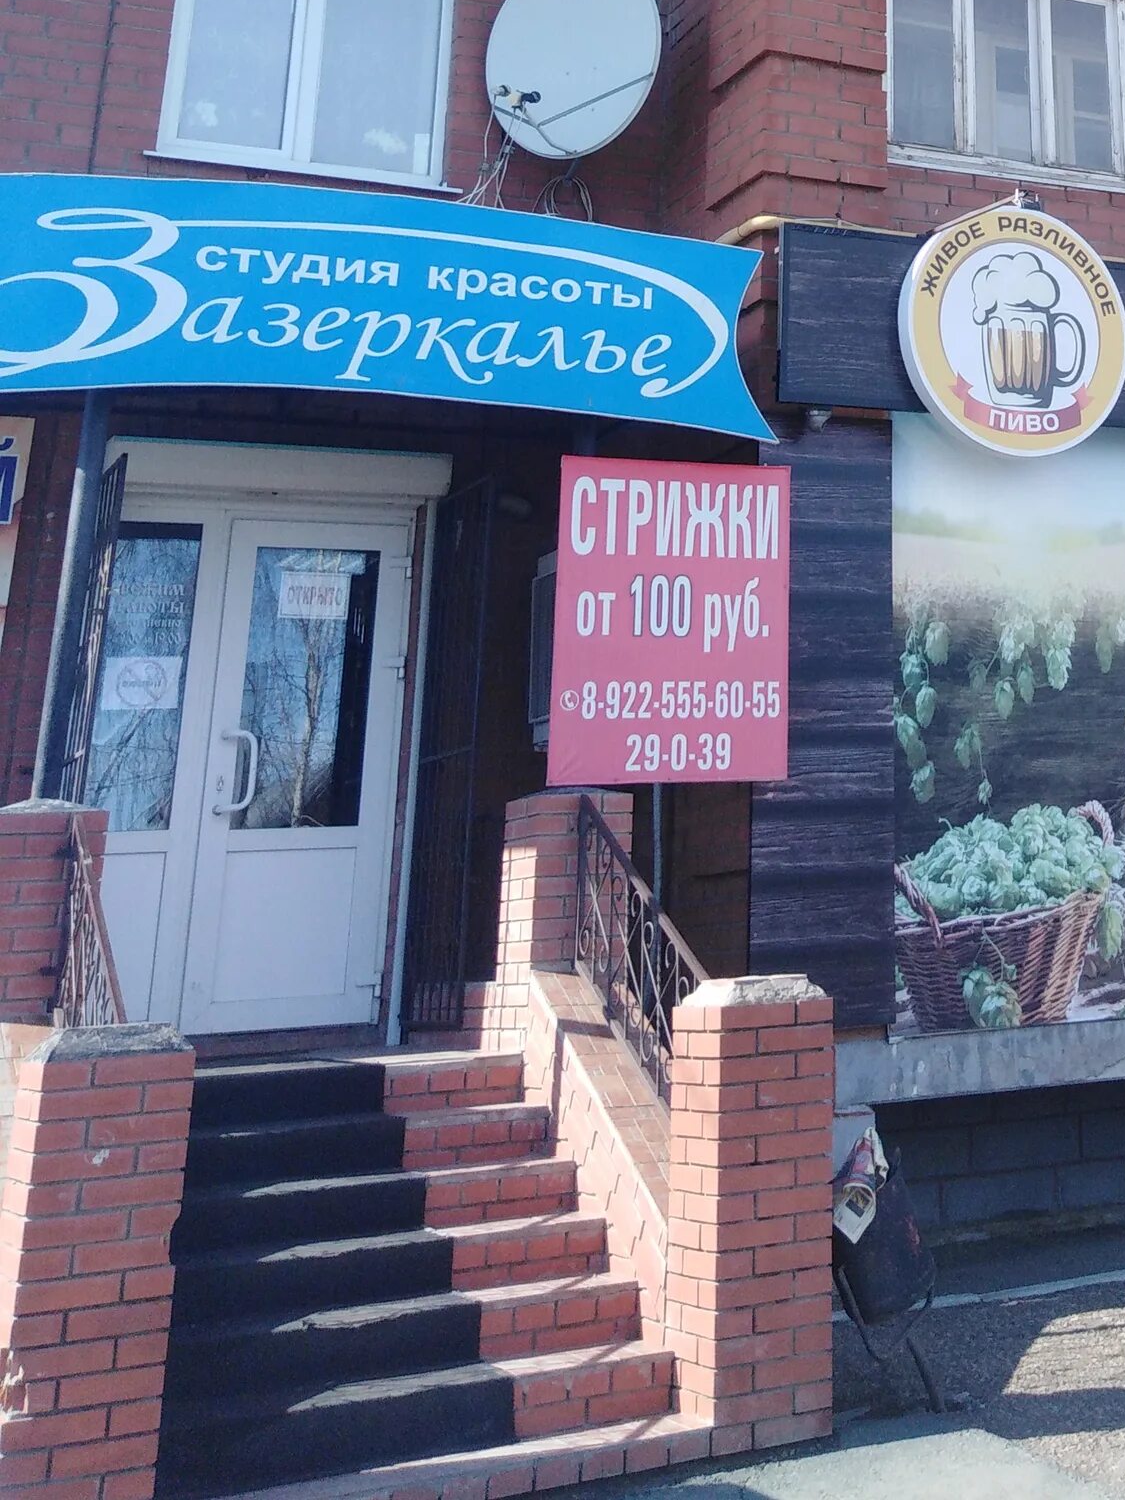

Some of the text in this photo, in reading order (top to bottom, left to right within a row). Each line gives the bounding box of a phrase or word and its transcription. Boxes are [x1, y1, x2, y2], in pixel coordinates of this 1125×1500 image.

[196, 245, 653, 311] студия красоты
[920, 215, 1117, 317] ЖИВОЕ РАЗЛИВНОЕ
[0, 208, 729, 398] Зазеркалье
[988, 410, 1061, 432] ПИВО
[570, 475, 780, 560] СТРИЖКИ
[287, 585, 343, 606] ОТКРЫТО
[576, 574, 770, 653] от 100 руб.
[581, 680, 781, 720] 8-922-555-60-55
[624, 732, 733, 772] 29-0-39
